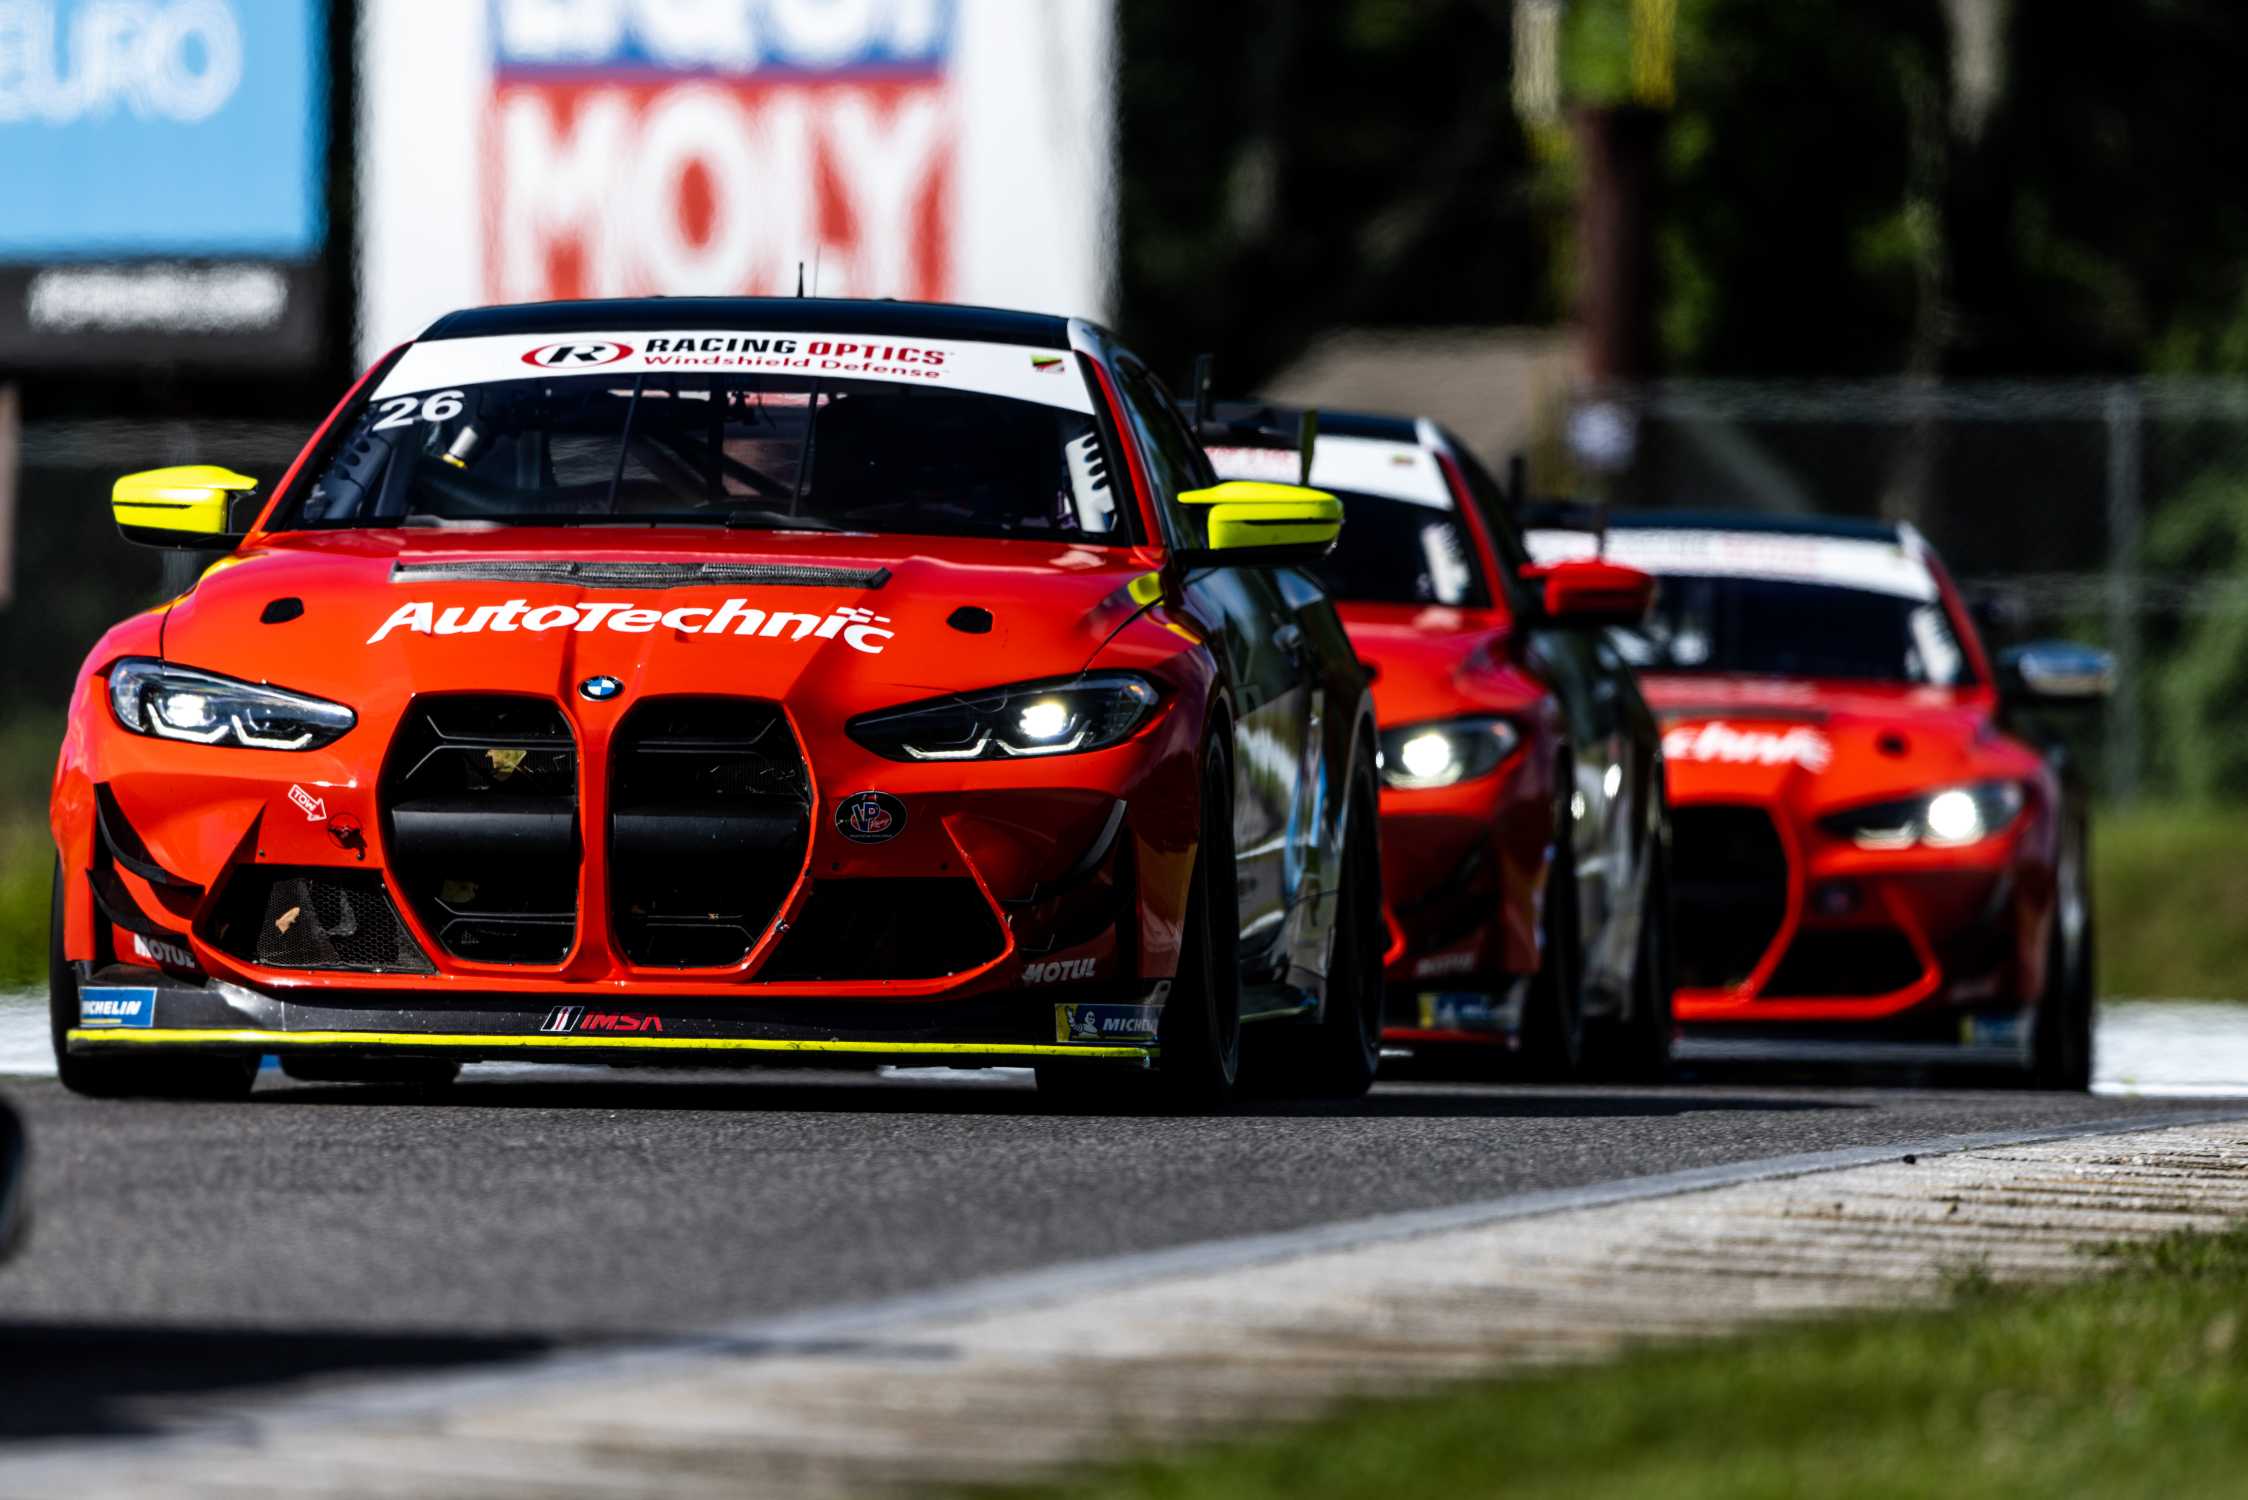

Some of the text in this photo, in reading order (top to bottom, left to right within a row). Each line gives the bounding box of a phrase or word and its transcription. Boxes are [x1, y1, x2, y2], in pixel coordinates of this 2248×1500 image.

[502, 85, 946, 302] MOLY
[645, 338, 945, 366] RACING OPTICS
[644, 356, 940, 378] Windshield Defense
[372, 390, 465, 431] 26
[294, 789, 316, 811] TOW
[134, 933, 195, 969] MOTUL
[1021, 958, 1096, 983] MOTUL
[580, 1013, 663, 1032] IMSA
